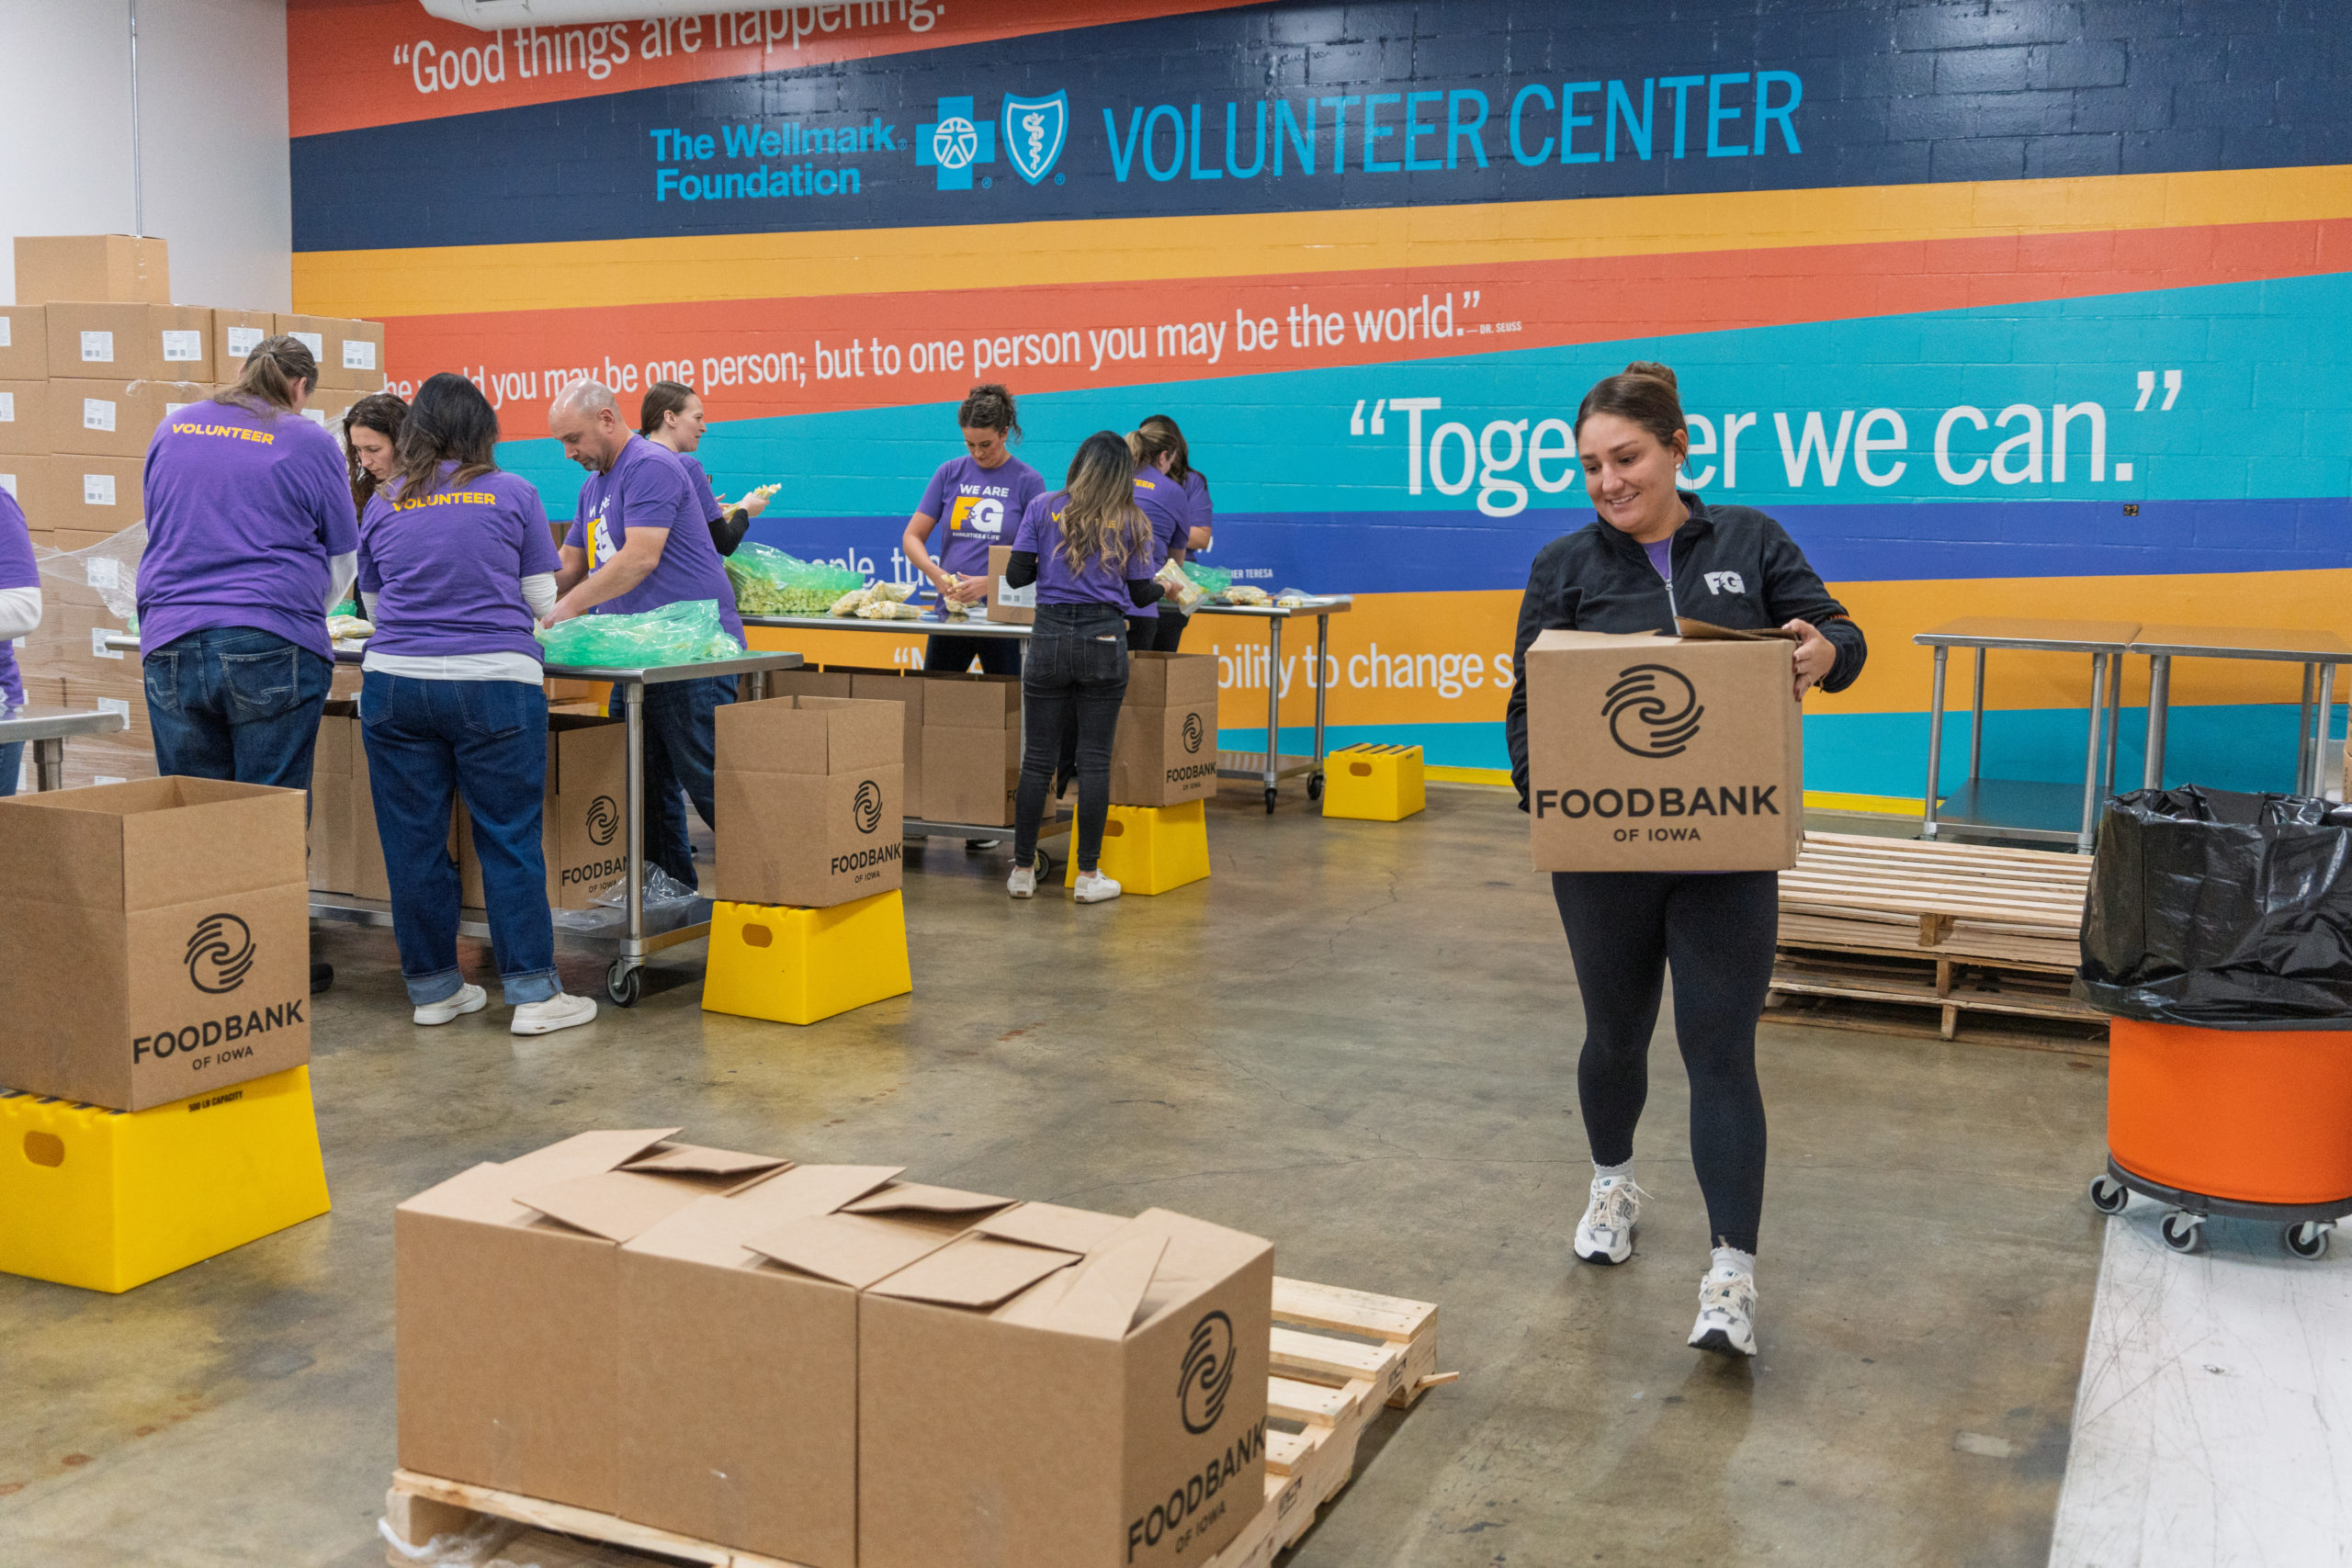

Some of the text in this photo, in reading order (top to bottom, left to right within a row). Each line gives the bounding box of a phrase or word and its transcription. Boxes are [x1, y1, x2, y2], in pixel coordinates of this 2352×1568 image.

[514, 27, 630, 80] things
[640, 15, 702, 60] are
[1102, 70, 1803, 183] VOLUNTEER CENTER
[650, 129, 715, 161] The
[656, 164, 860, 201] Foundation
[1496, 321, 1521, 333] SEUSS
[492, 369, 537, 410] you
[605, 355, 638, 393] be
[645, 359, 695, 391] one
[702, 351, 806, 396] person;
[815, 339, 864, 379] but
[870, 337, 901, 375] to
[909, 339, 964, 373] one
[974, 330, 1080, 378] person
[1089, 327, 1146, 371] you
[1157, 320, 1227, 364] may
[1237, 309, 1279, 352] be
[1287, 303, 1344, 348] the
[1353, 290, 1480, 344] world.”
[172, 423, 275, 445] VOLUNTEER
[1350, 369, 2182, 517] “Togeer we can.”
[392, 492, 496, 512] VOLUNTEER
[959, 483, 1010, 497] WE ARE
[1245, 569, 1273, 579] TERESA
[1302, 645, 1339, 688] to
[1348, 643, 1484, 698] change
[1166, 761, 1216, 783] FOODBANK
[1536, 784, 1780, 818] FOODBANK
[1613, 828, 1701, 842] OF IOWA
[561, 856, 627, 886] FOODBA
[831, 842, 901, 875] FOODBANK
[589, 884, 598, 893] OF
[854, 870, 880, 884] OF IOWA
[133, 998, 304, 1064] FOODBANK
[192, 1045, 254, 1070] OF IOWA
[211, 1090, 243, 1106] CAPACITY
[1128, 1416, 1267, 1563] FOODBANK
[1175, 1502, 1226, 1554] OF IOWA
